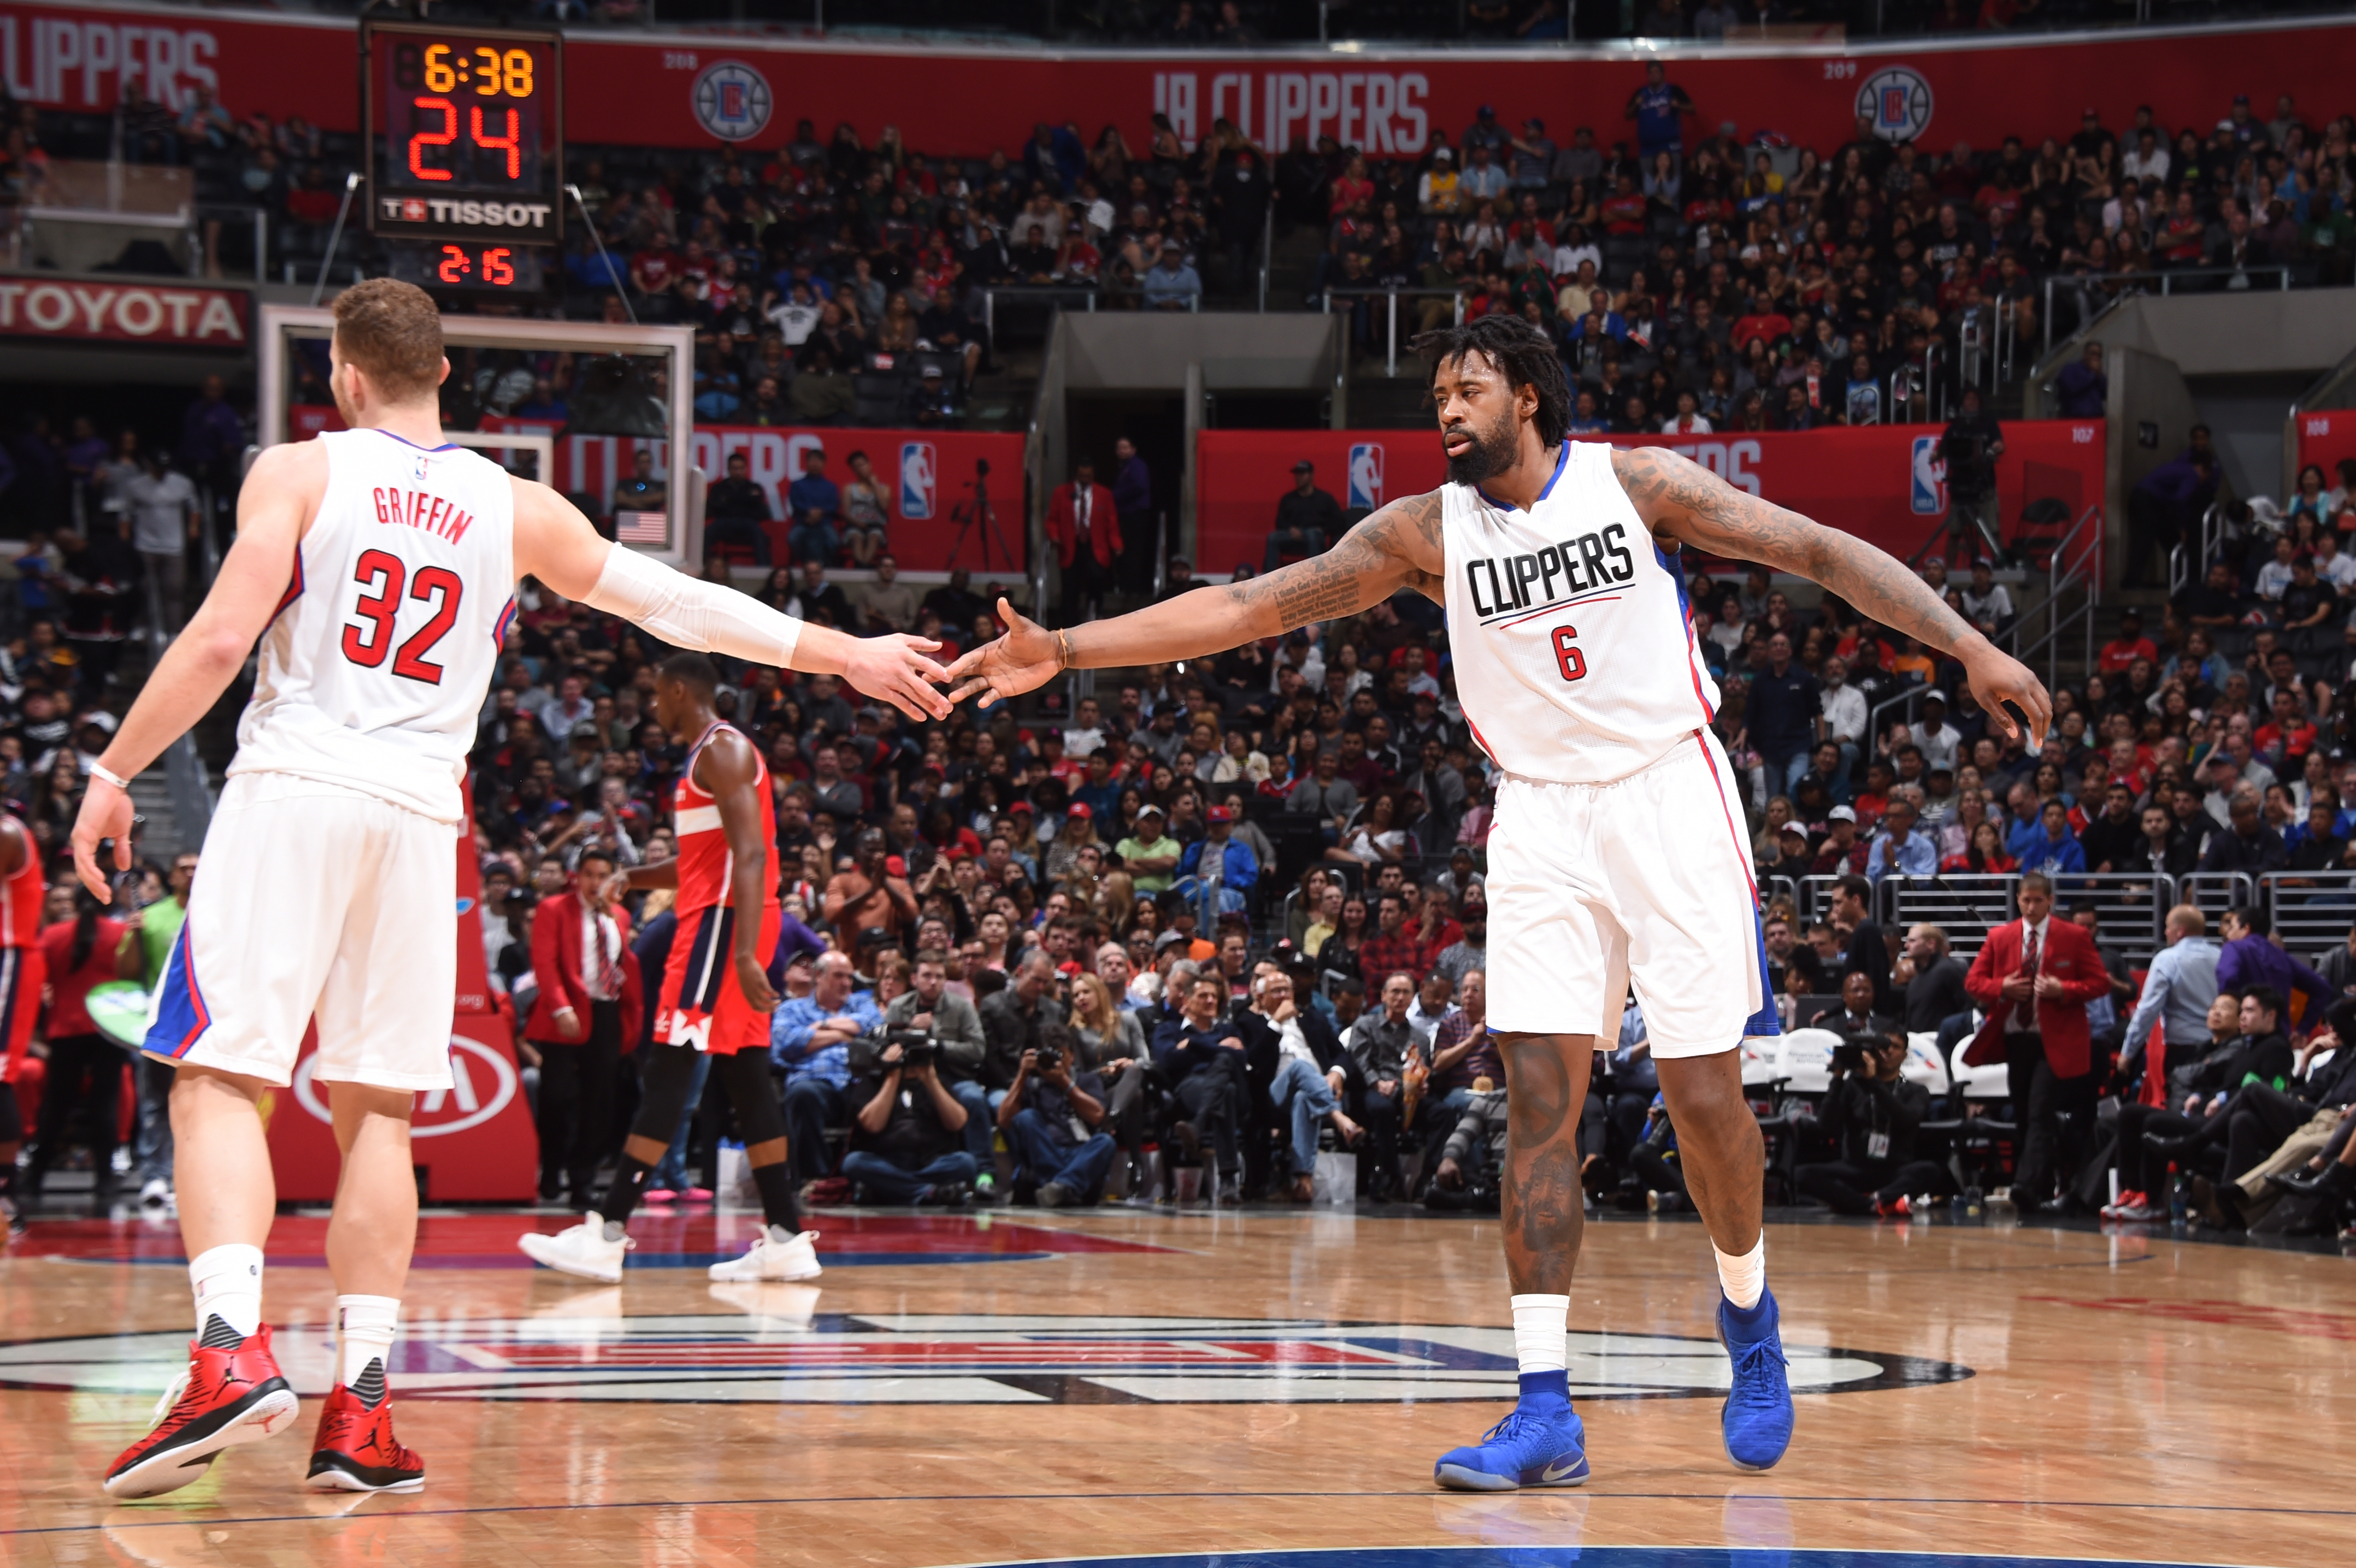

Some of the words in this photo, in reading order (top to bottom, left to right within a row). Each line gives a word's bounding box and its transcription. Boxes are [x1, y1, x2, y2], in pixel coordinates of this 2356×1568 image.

[0, 15, 217, 112] LIPPERS
[425, 44, 533, 97] 6:38
[1823, 62, 1857, 80] 209
[408, 96, 520, 181] 24
[1212, 73, 1429, 154] CLIPPERS
[427, 198, 551, 228] TISSOT
[0, 284, 244, 341] TOYOTA
[373, 487, 474, 546] GRIFFIN
[1466, 522, 1634, 617] CLIPPERS
[341, 549, 463, 687] 32
[1551, 625, 1587, 681] 6
